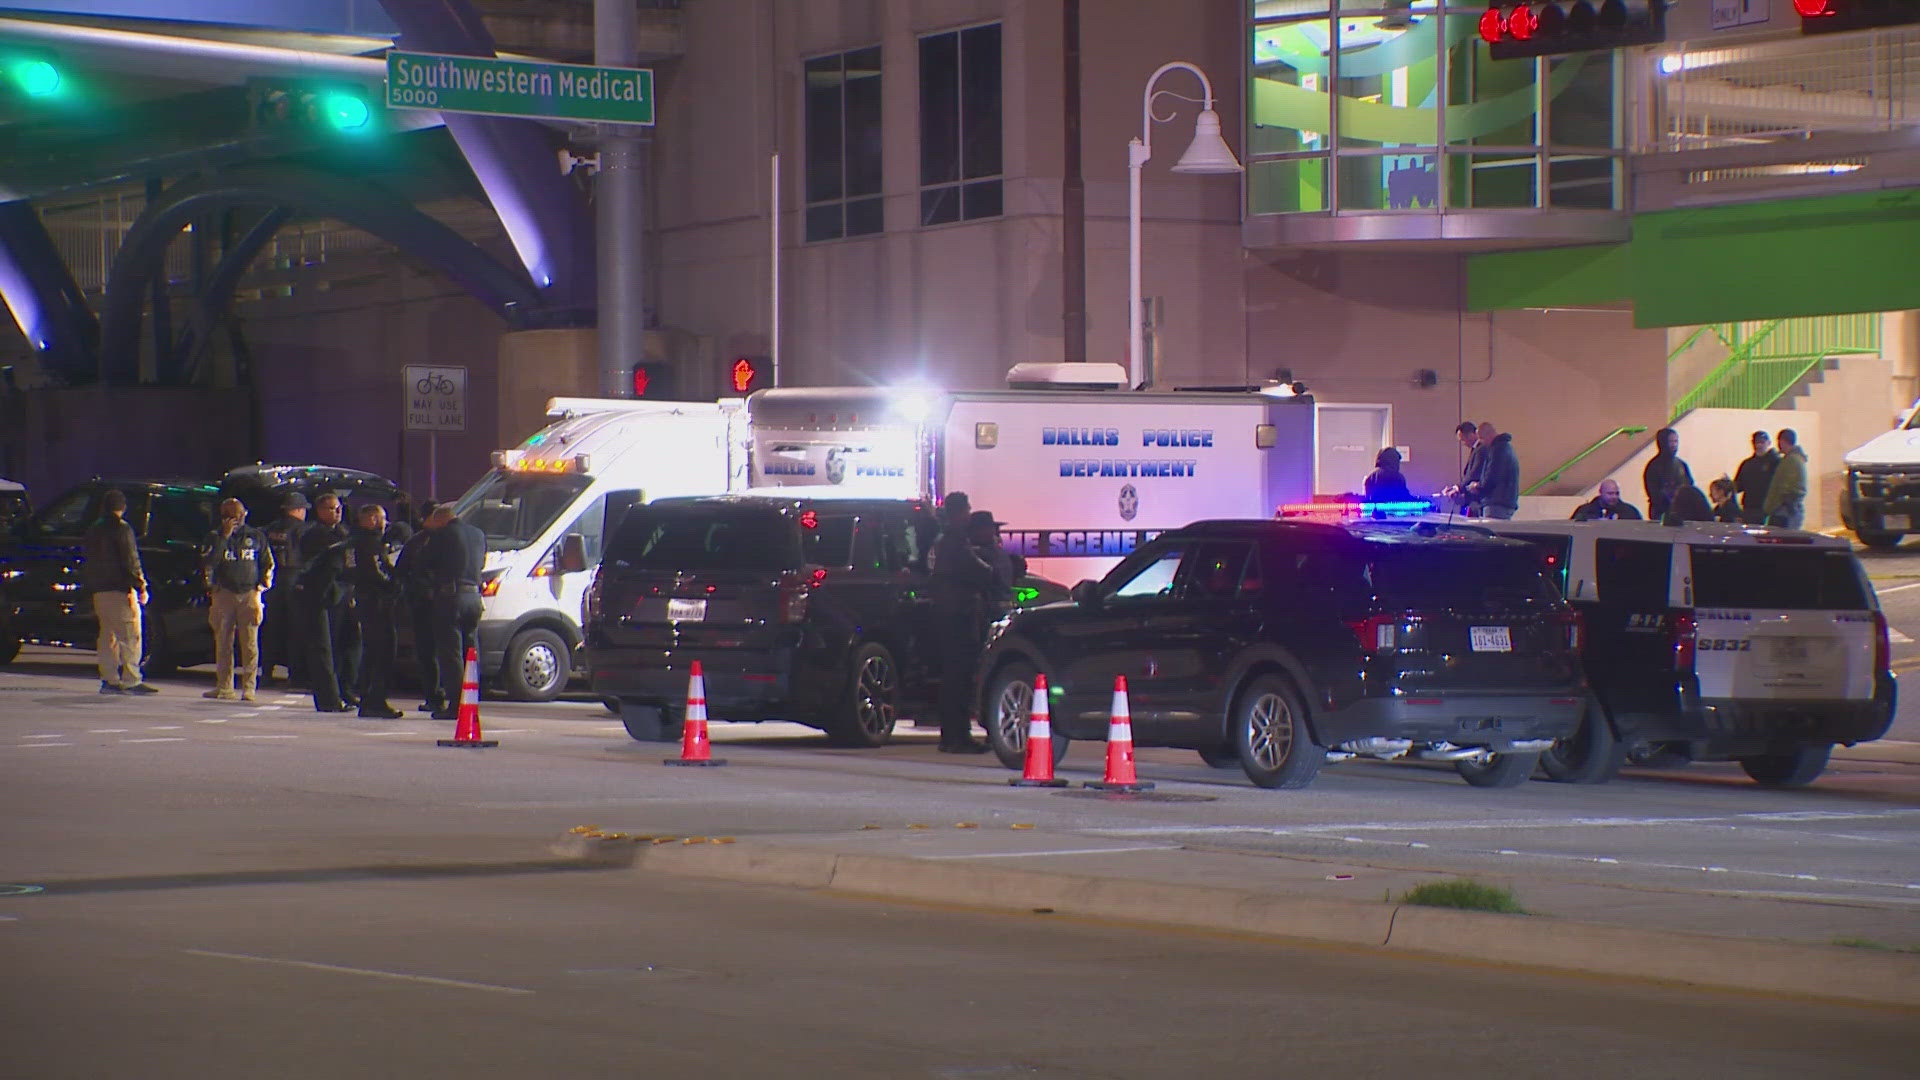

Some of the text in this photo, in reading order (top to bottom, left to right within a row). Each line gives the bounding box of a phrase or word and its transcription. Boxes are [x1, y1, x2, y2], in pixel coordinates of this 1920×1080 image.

[397, 59, 644, 102] Southwestern Medical
[393, 88, 438, 105] 5000
[413, 400, 458, 410] MAY USE
[409, 413, 463, 425] FULL LANE
[1042, 427, 1214, 448] DALLAS POLICE
[764, 462, 905, 477] DALLAS POLICE
[1059, 459, 1197, 477] DEPARTMENT
[1048, 531, 1138, 555] SCENE
[1698, 639, 1752, 651] S832
